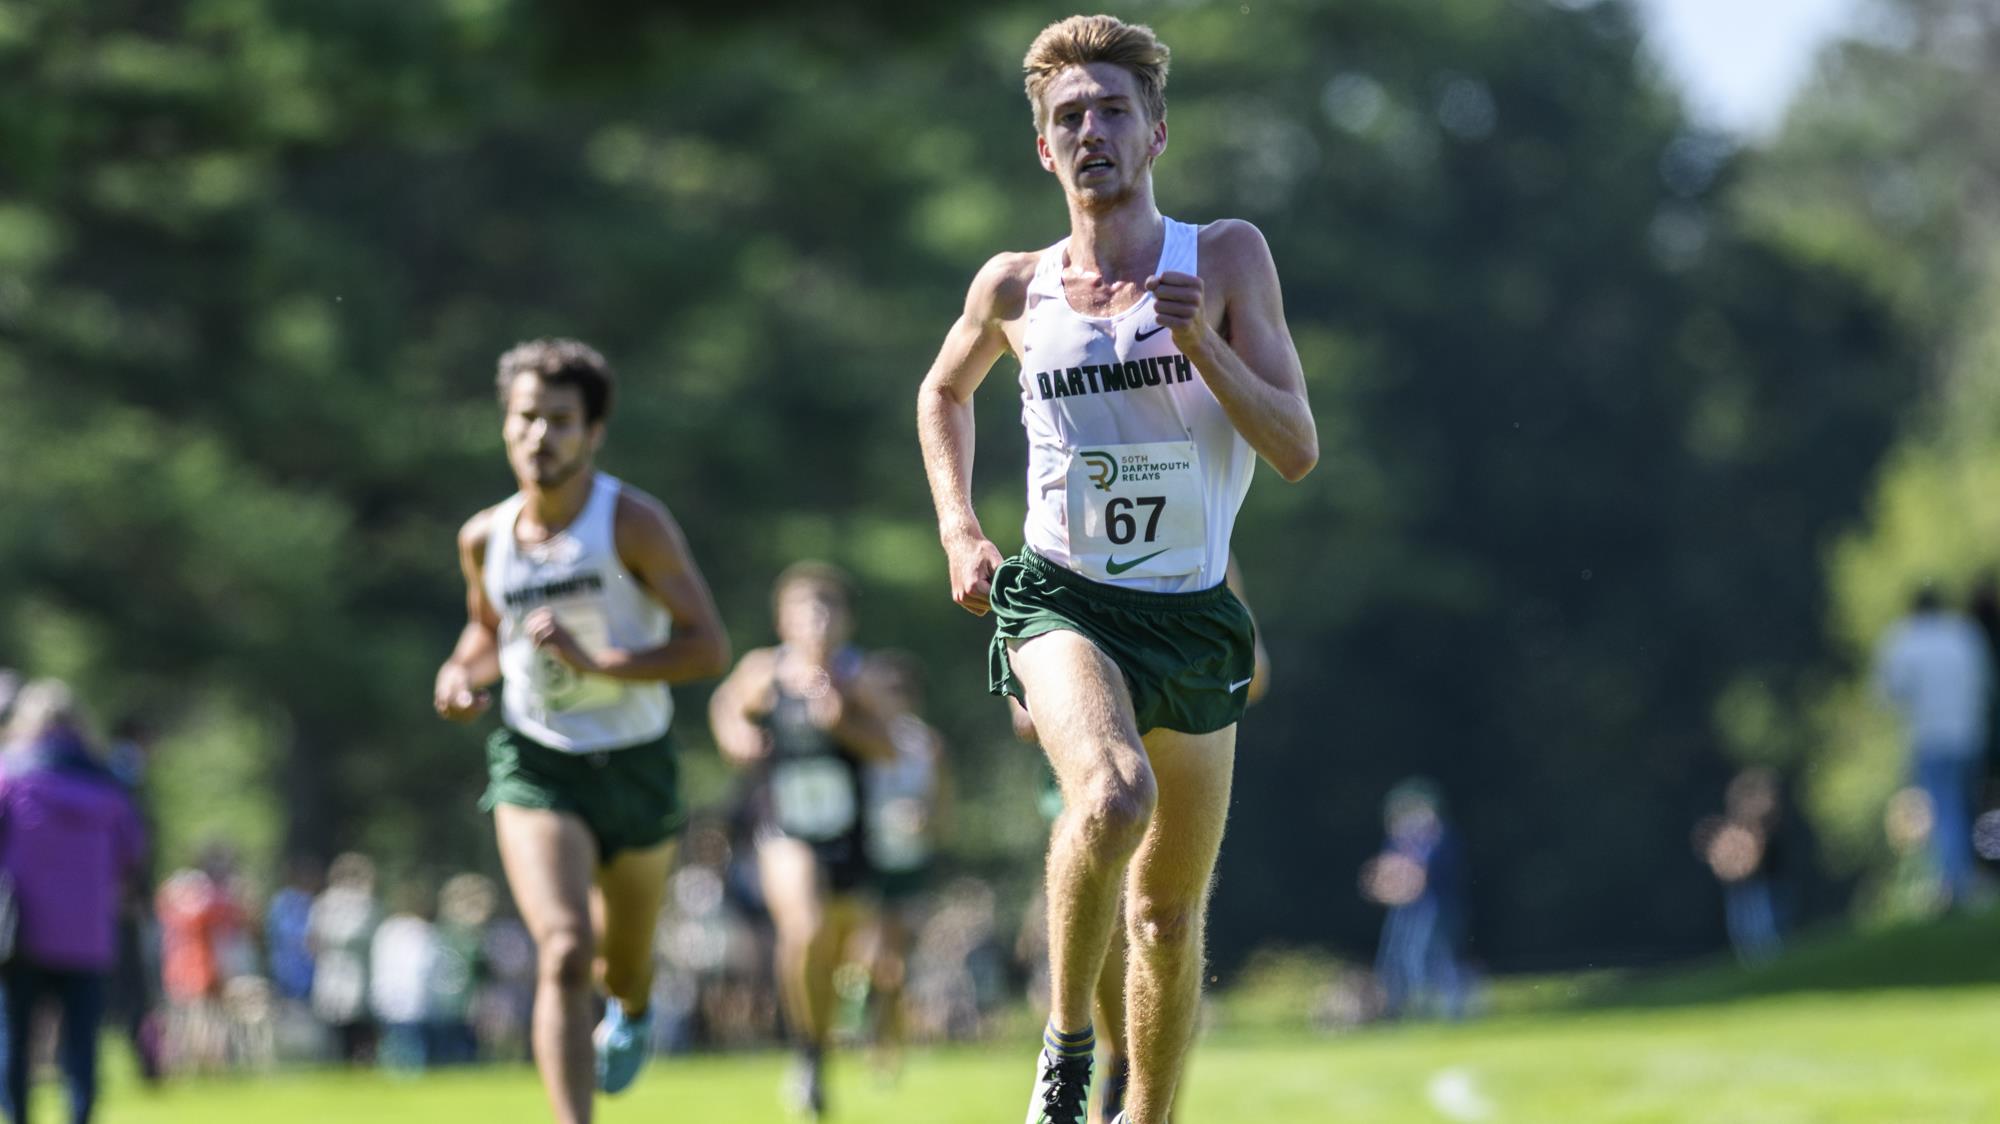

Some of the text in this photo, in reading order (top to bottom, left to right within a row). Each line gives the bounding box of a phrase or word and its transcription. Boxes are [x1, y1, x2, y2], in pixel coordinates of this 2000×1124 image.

[1037, 355, 1193, 400] DARTMOUTH
[1121, 455, 1149, 464] 50TH
[1121, 462, 1190, 473] DARTMOUTH
[1122, 472, 1161, 482] RELAYS
[1105, 496, 1167, 545] 67
